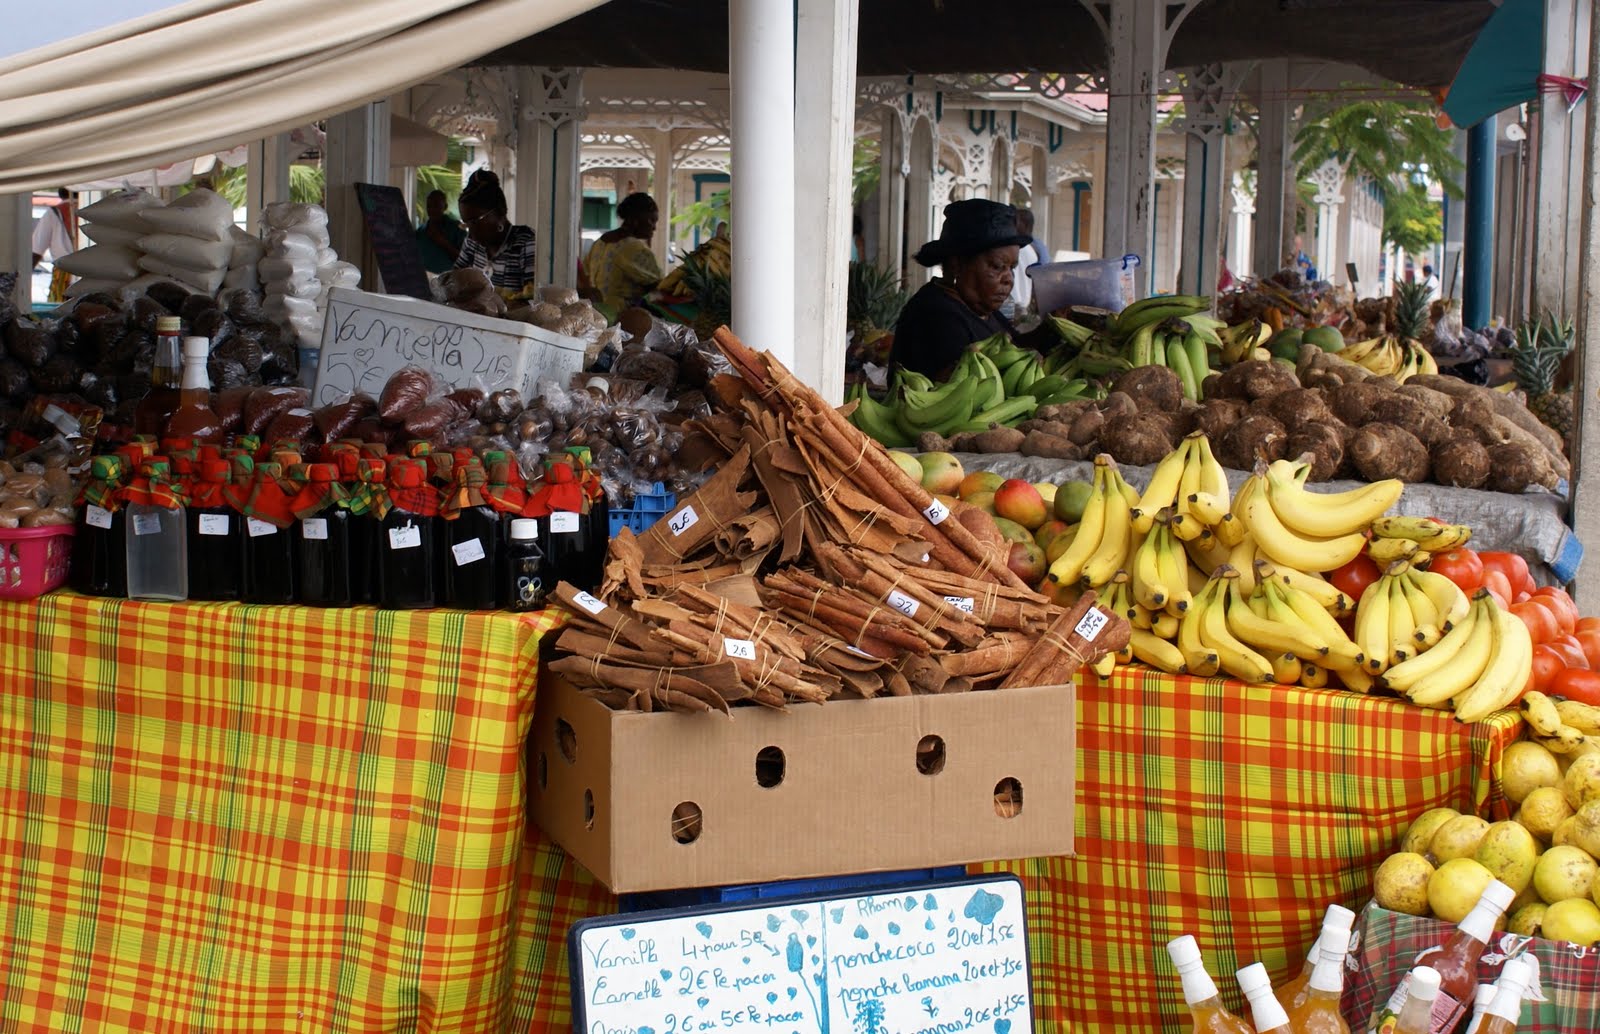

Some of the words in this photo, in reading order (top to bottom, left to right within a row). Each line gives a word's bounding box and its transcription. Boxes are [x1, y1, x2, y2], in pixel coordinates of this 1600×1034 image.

[682, 936, 698, 959] 4
[679, 965, 710, 995] 2€
[721, 1010, 745, 1027] 5€
